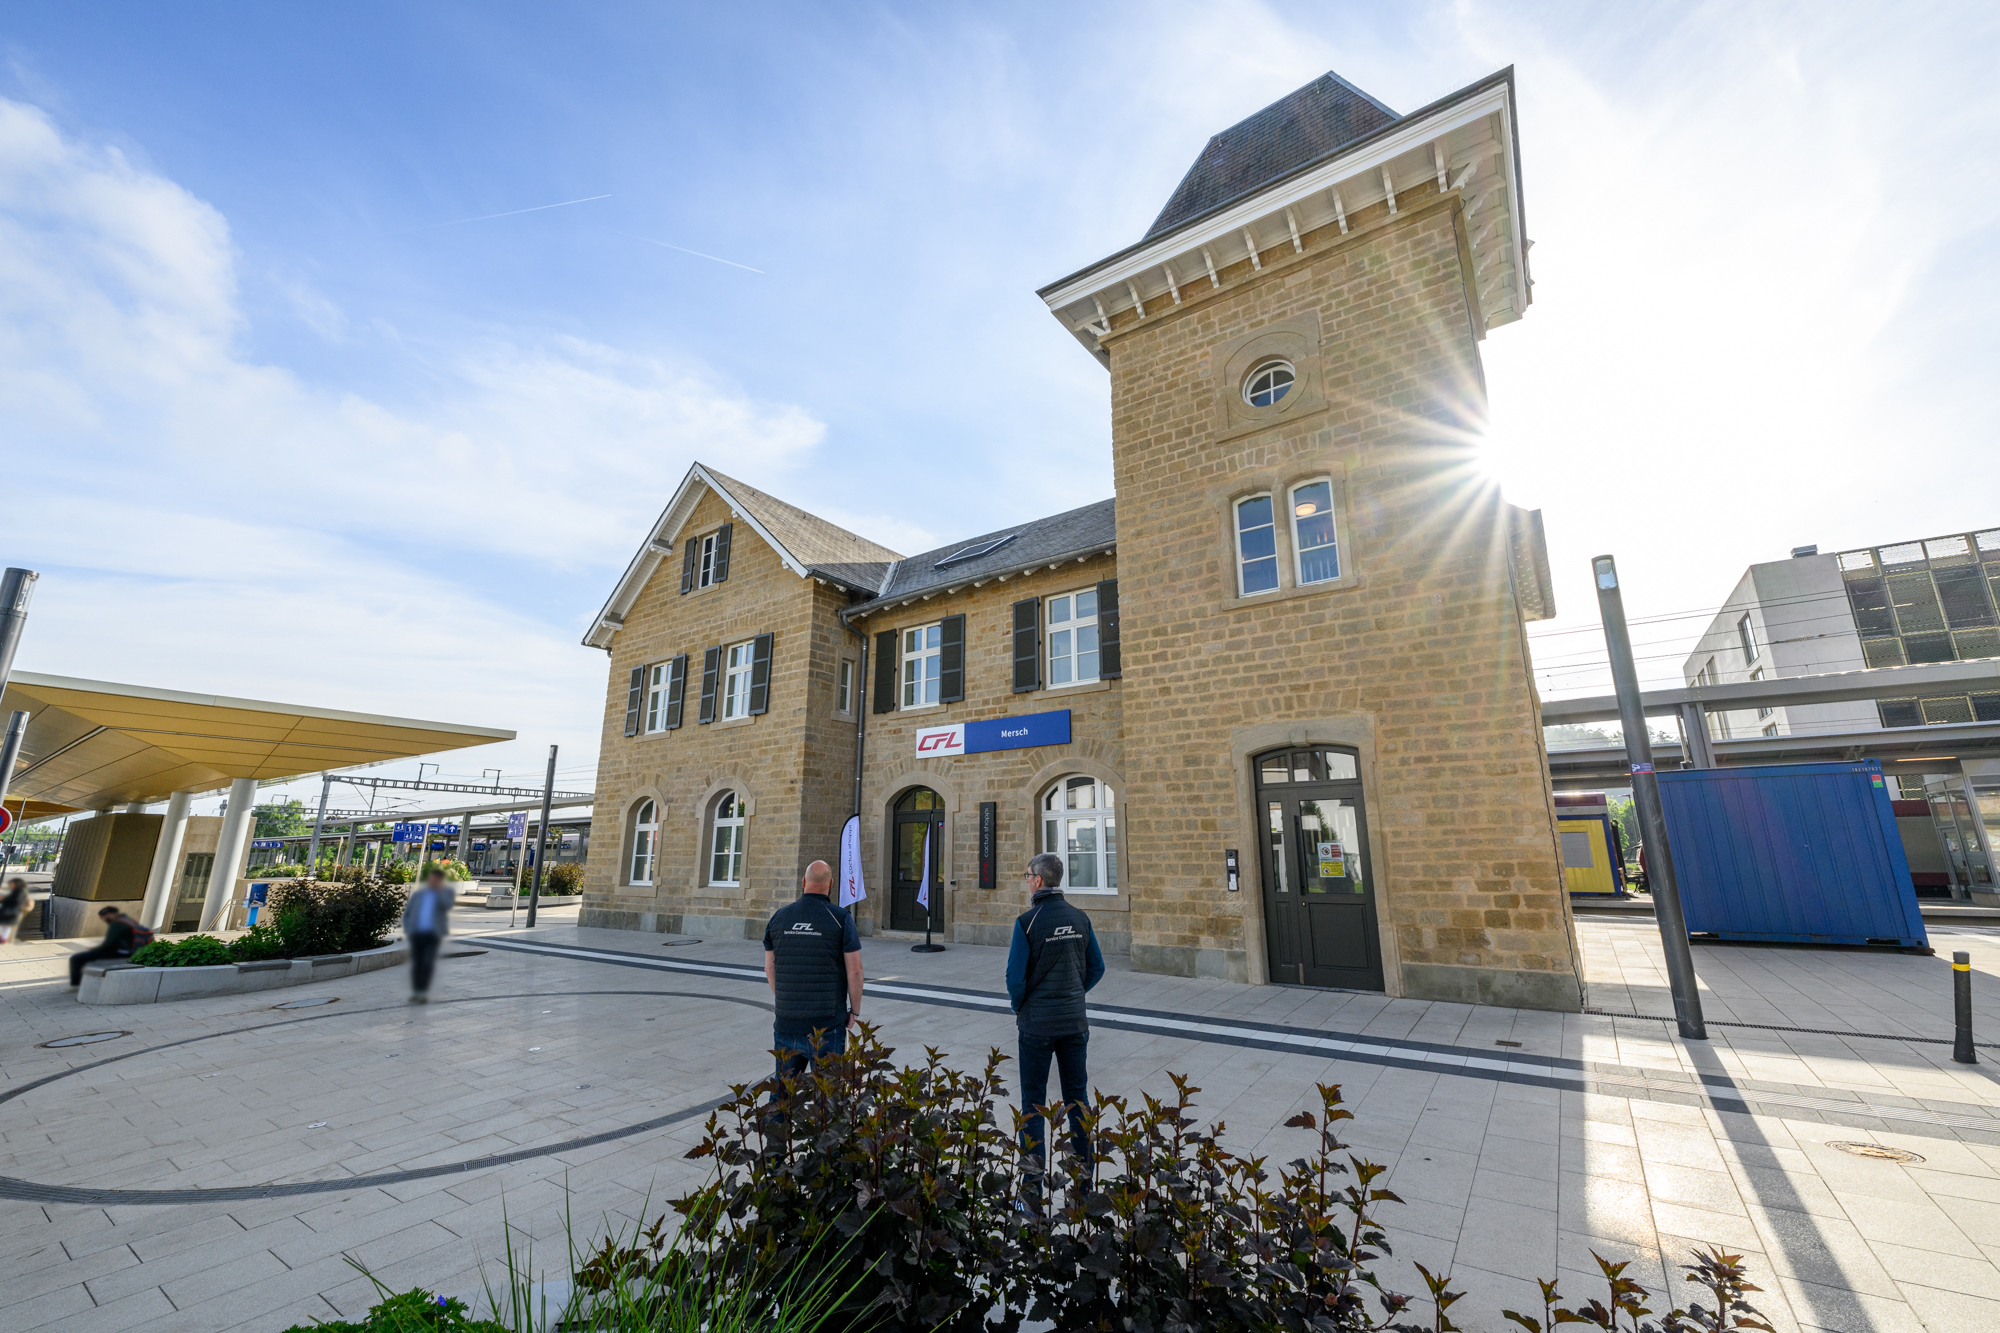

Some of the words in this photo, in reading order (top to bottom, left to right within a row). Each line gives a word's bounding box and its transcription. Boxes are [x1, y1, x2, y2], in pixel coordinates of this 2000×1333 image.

[918, 731, 962, 751] CFL
[1001, 727, 1028, 738] Mersch
[848, 876, 856, 898] CFL
[792, 922, 813, 930] CFL
[1054, 926, 1075, 935] CFL
